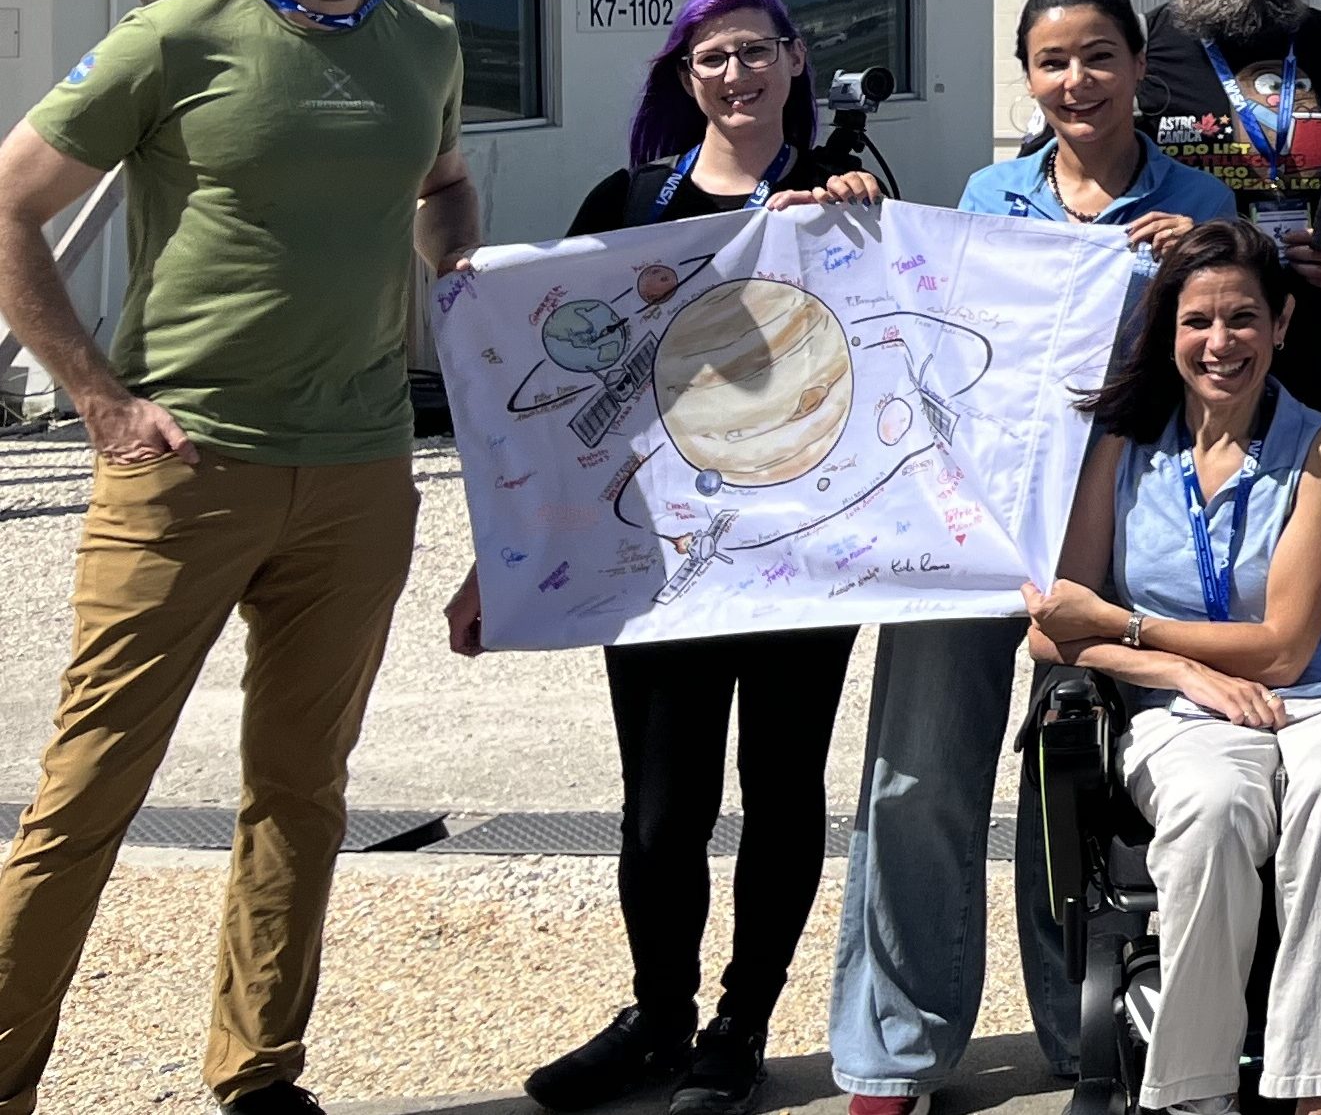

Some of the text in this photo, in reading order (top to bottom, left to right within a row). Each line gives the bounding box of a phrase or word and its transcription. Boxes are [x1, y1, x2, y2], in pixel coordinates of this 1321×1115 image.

[1222, 78, 1248, 112] NASA
[1182, 144, 1209, 156] DO
[1213, 142, 1251, 156] LIST
[656, 172, 683, 206] NASA
[1240, 439, 1263, 479] NASA
